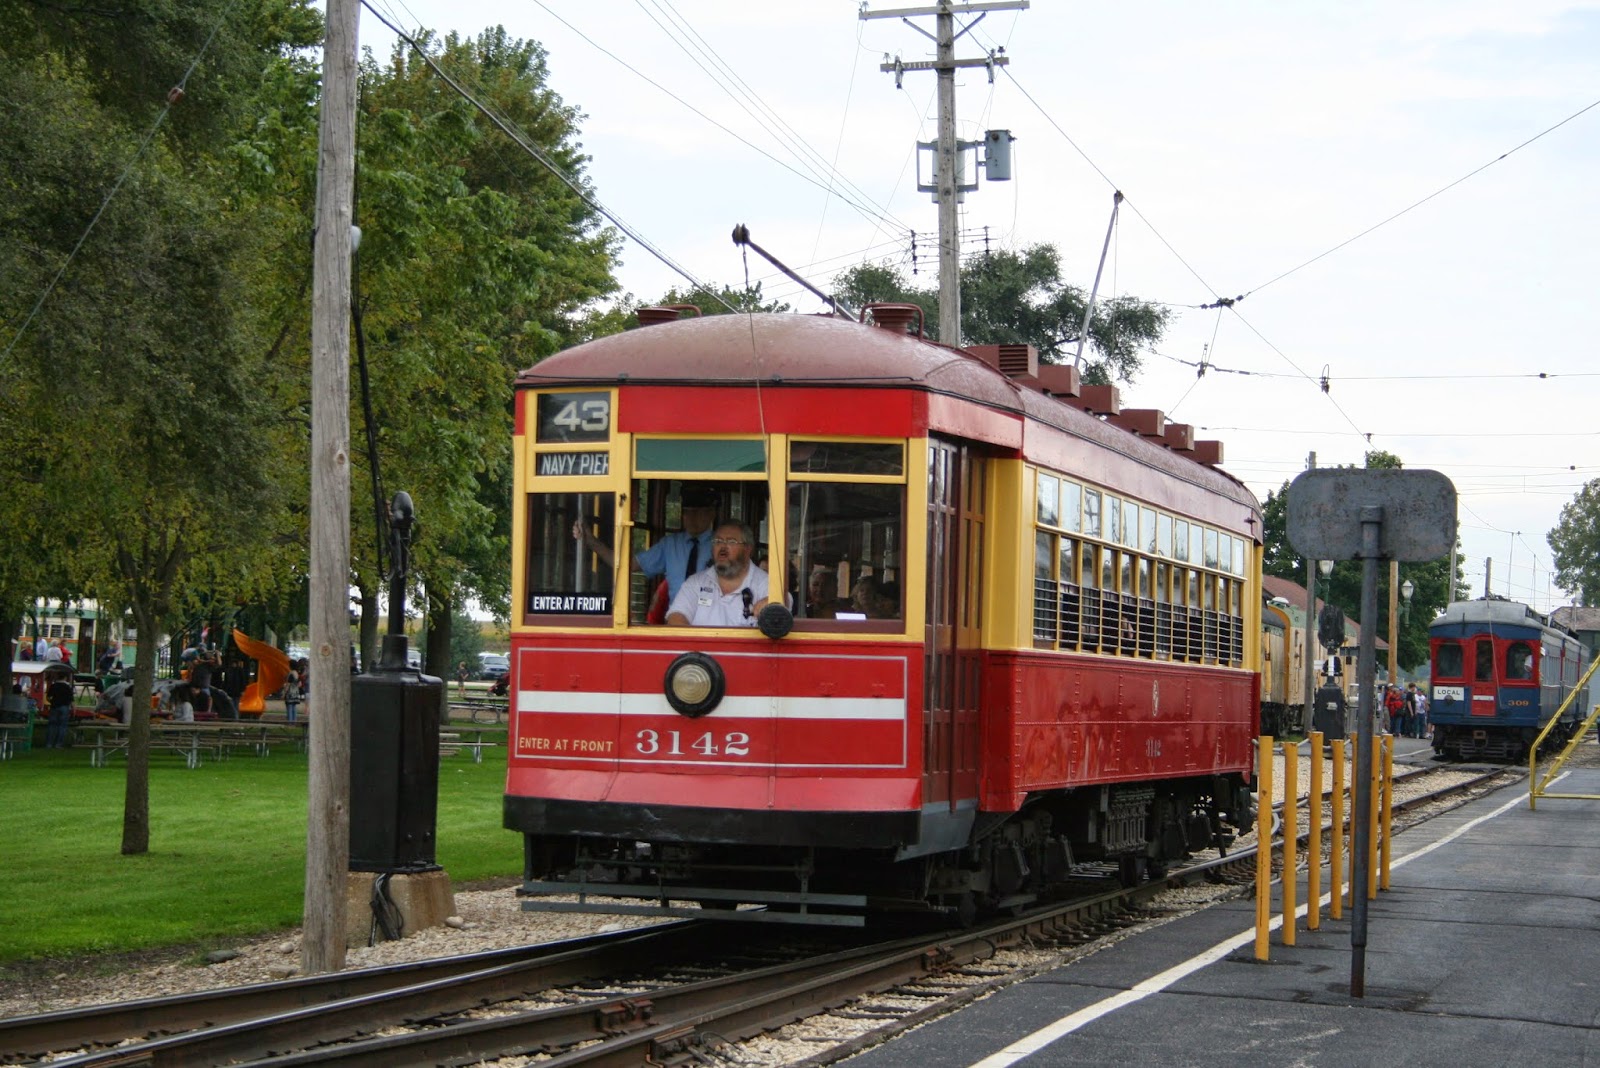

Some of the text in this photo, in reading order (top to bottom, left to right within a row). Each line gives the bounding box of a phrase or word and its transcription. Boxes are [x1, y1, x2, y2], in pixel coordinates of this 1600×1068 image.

[554, 400, 609, 432] 43
[541, 453, 577, 475] NAVY
[533, 596, 608, 612] ENTER AT FRONT
[519, 737, 613, 752] ENTER AT FRONT
[636, 728, 749, 756] 3142
